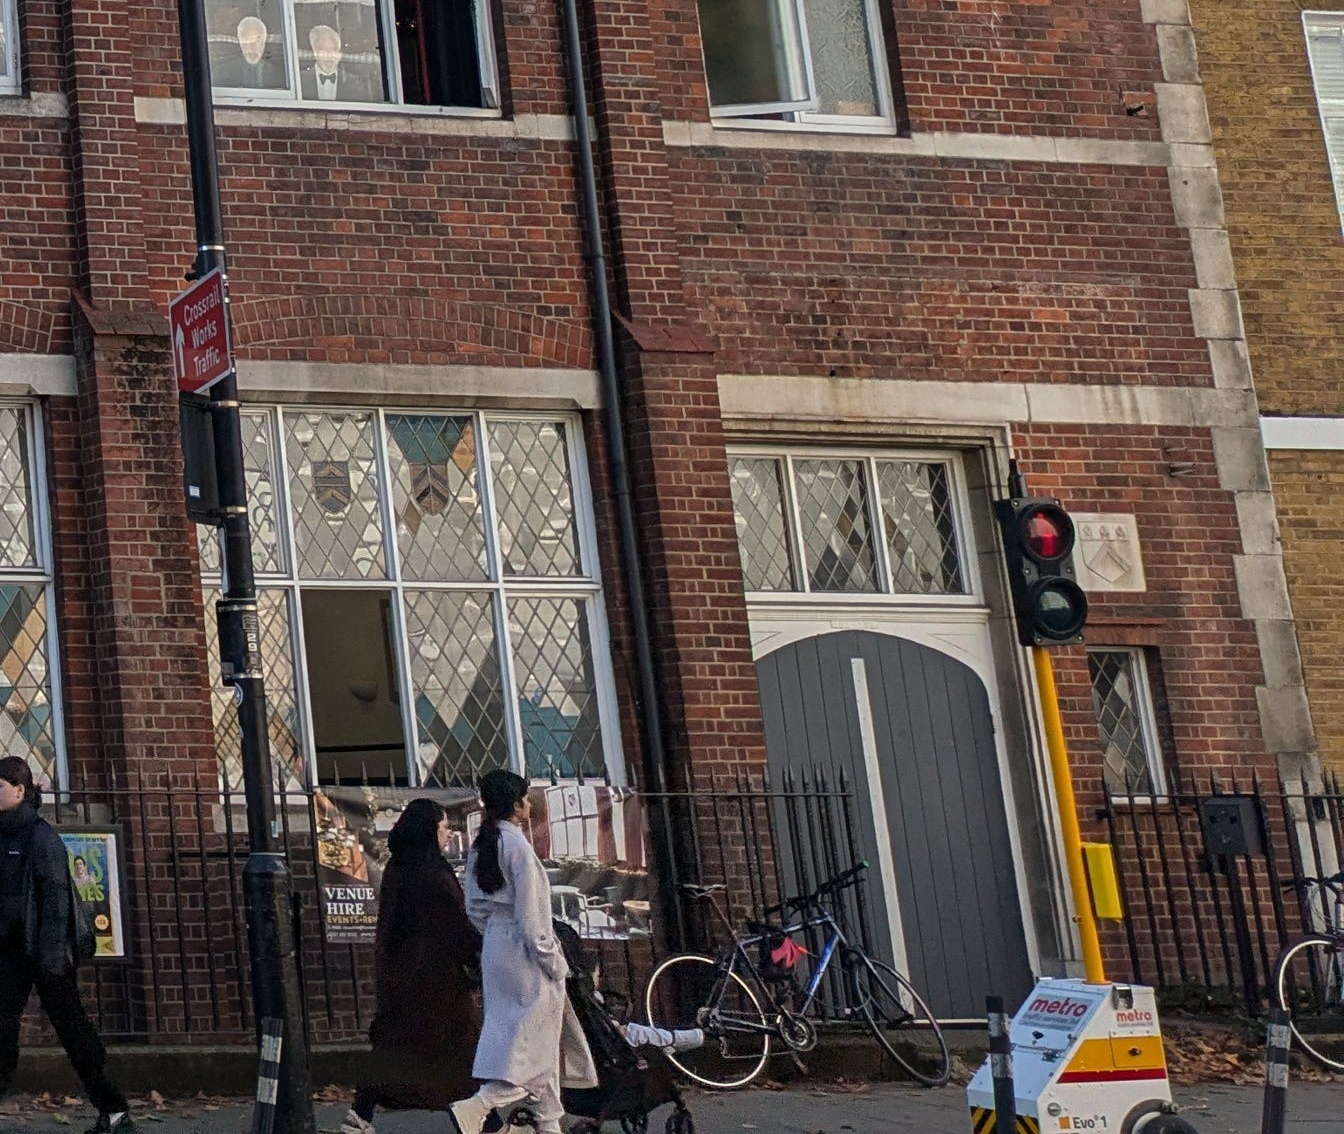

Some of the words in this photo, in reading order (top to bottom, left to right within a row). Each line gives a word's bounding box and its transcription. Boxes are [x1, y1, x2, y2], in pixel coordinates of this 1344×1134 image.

[184, 284, 221, 326] Crossrail
[191, 319, 218, 350] Works
[193, 345, 221, 377] Traffic
[324, 887, 375, 900] VENUE
[326, 902, 365, 915] HIRE
[1028, 997, 1088, 1017] metro
[1116, 1009, 1152, 1022] metro
